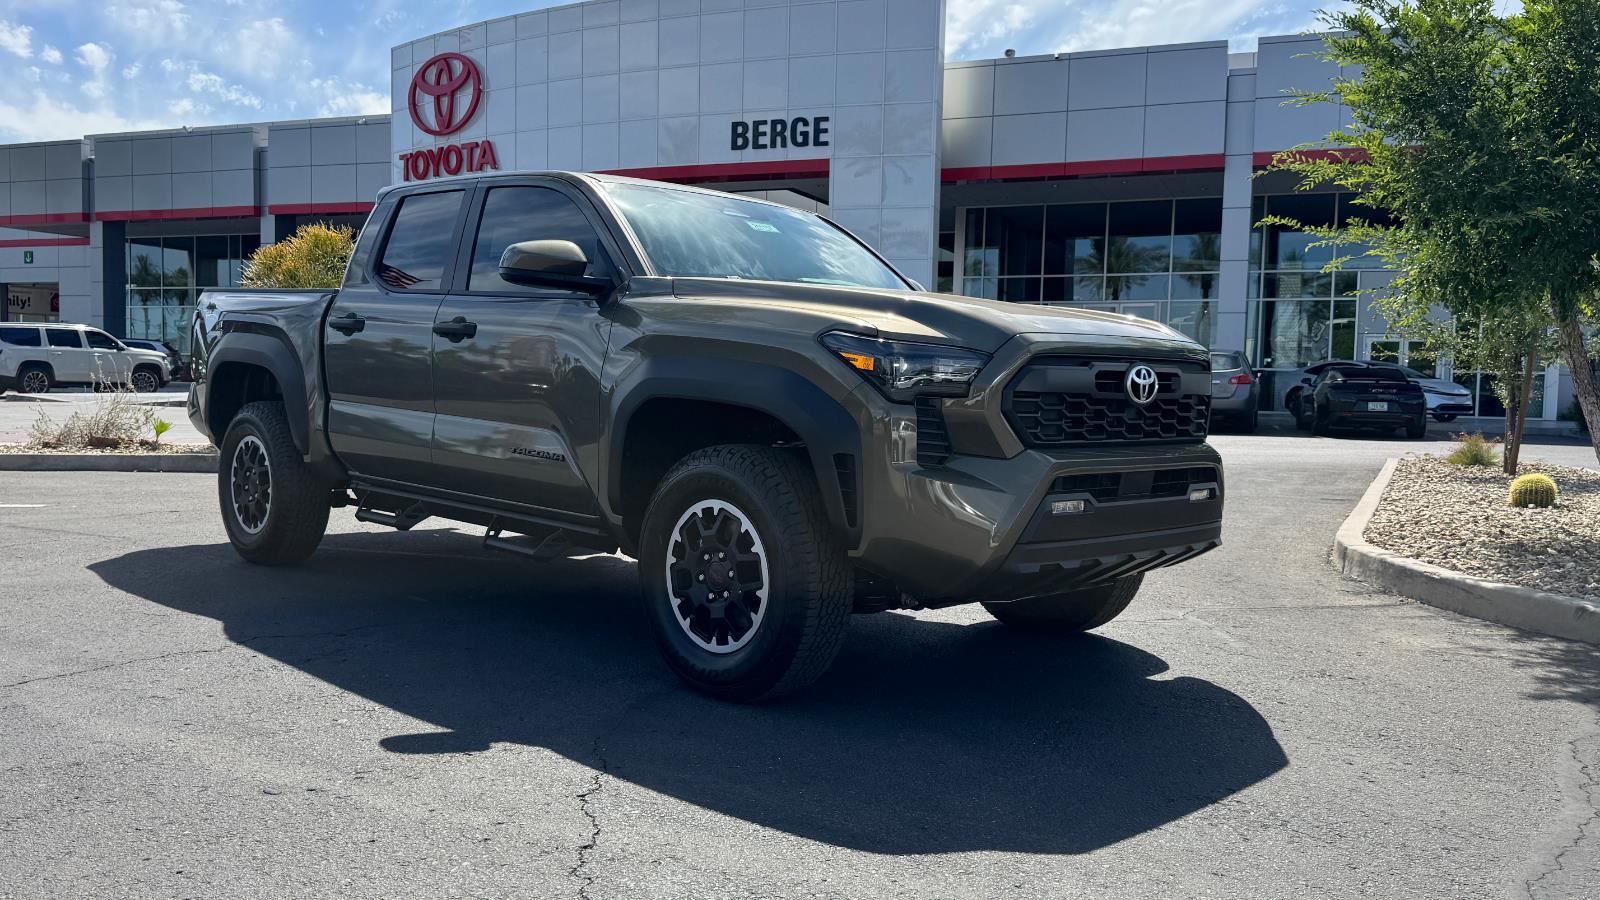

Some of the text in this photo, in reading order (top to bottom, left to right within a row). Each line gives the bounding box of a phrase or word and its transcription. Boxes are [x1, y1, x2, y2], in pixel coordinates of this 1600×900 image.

[731, 117, 829, 150] BERGE
[399, 140, 498, 181] TOYOTA
[510, 446, 565, 461] TACOMA
